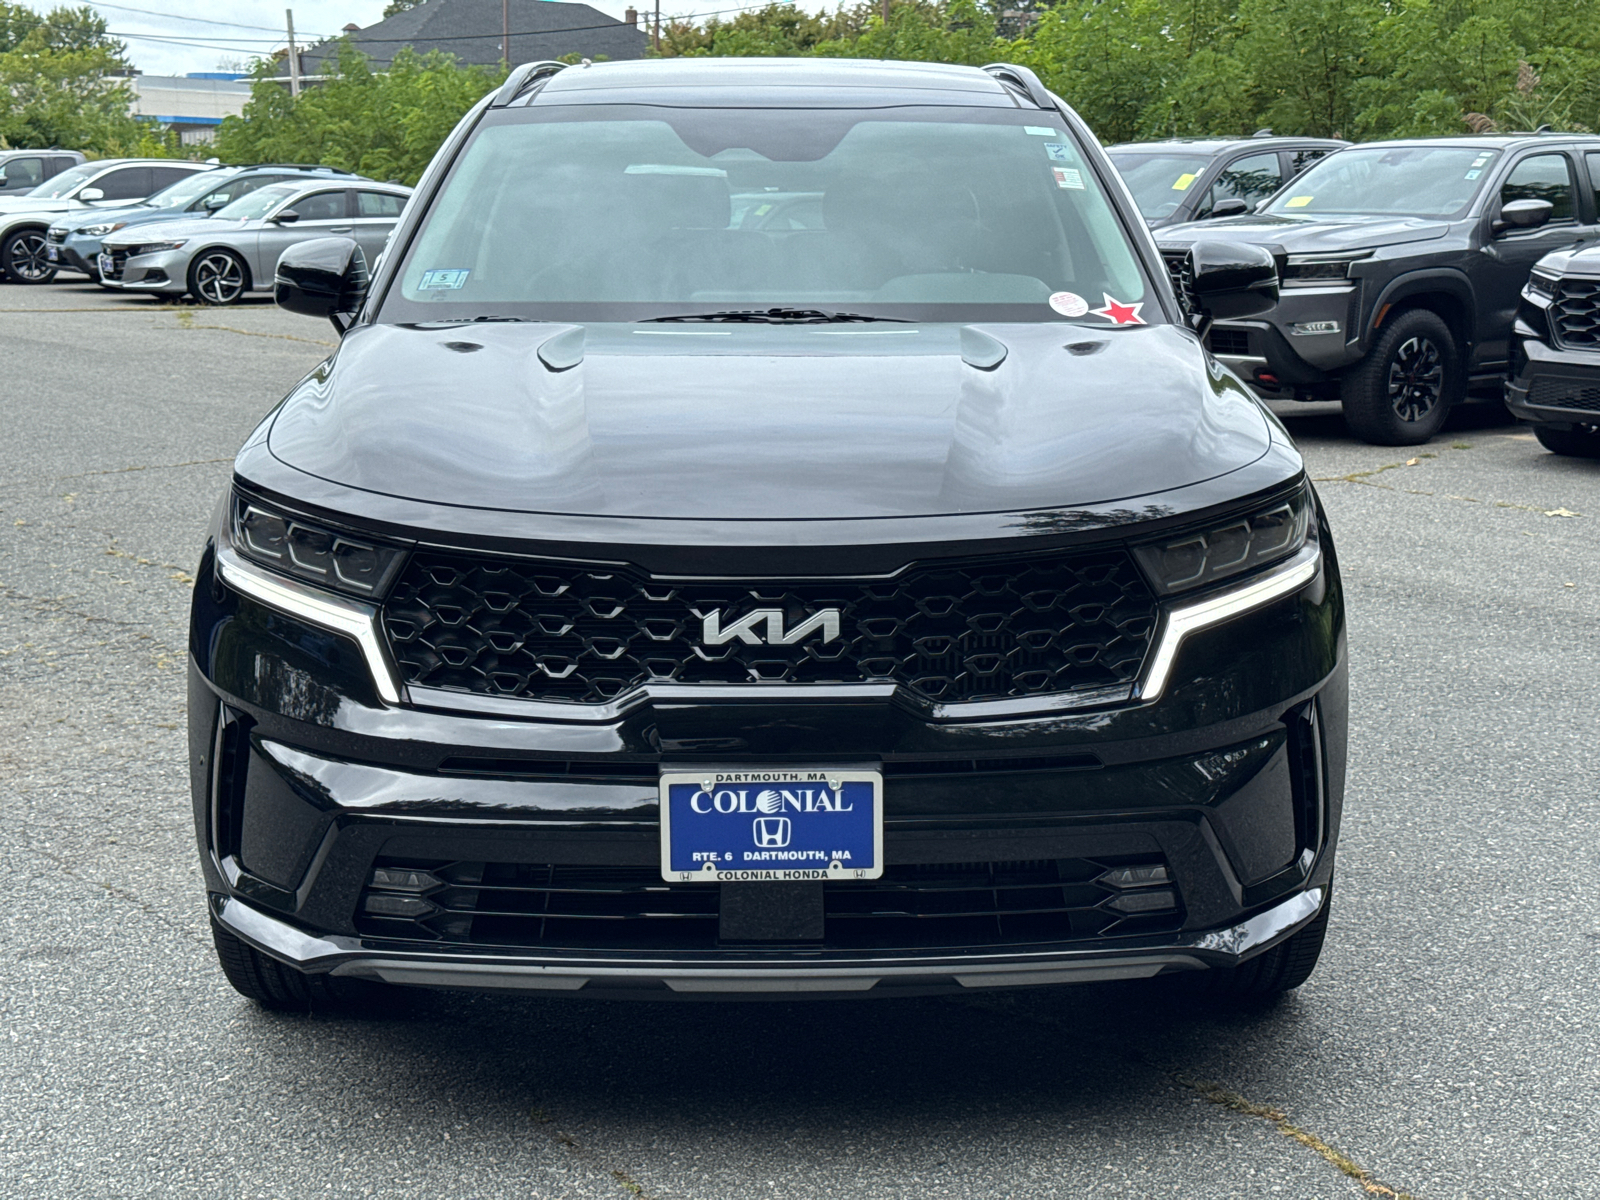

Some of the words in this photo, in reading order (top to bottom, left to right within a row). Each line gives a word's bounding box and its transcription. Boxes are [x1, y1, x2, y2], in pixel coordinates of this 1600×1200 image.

[703, 607, 841, 646] KIA
[715, 773, 803, 782] DARTMOUTH,
[807, 772, 827, 781] MA
[690, 789, 854, 814] COLONIAL
[692, 851, 722, 862] RTE.
[724, 851, 734, 861] 6
[743, 850, 829, 862] DARTMOUTH,
[831, 850, 852, 860] MA
[716, 870, 780, 880] COLONIAL
[783, 869, 830, 880] HONDA
